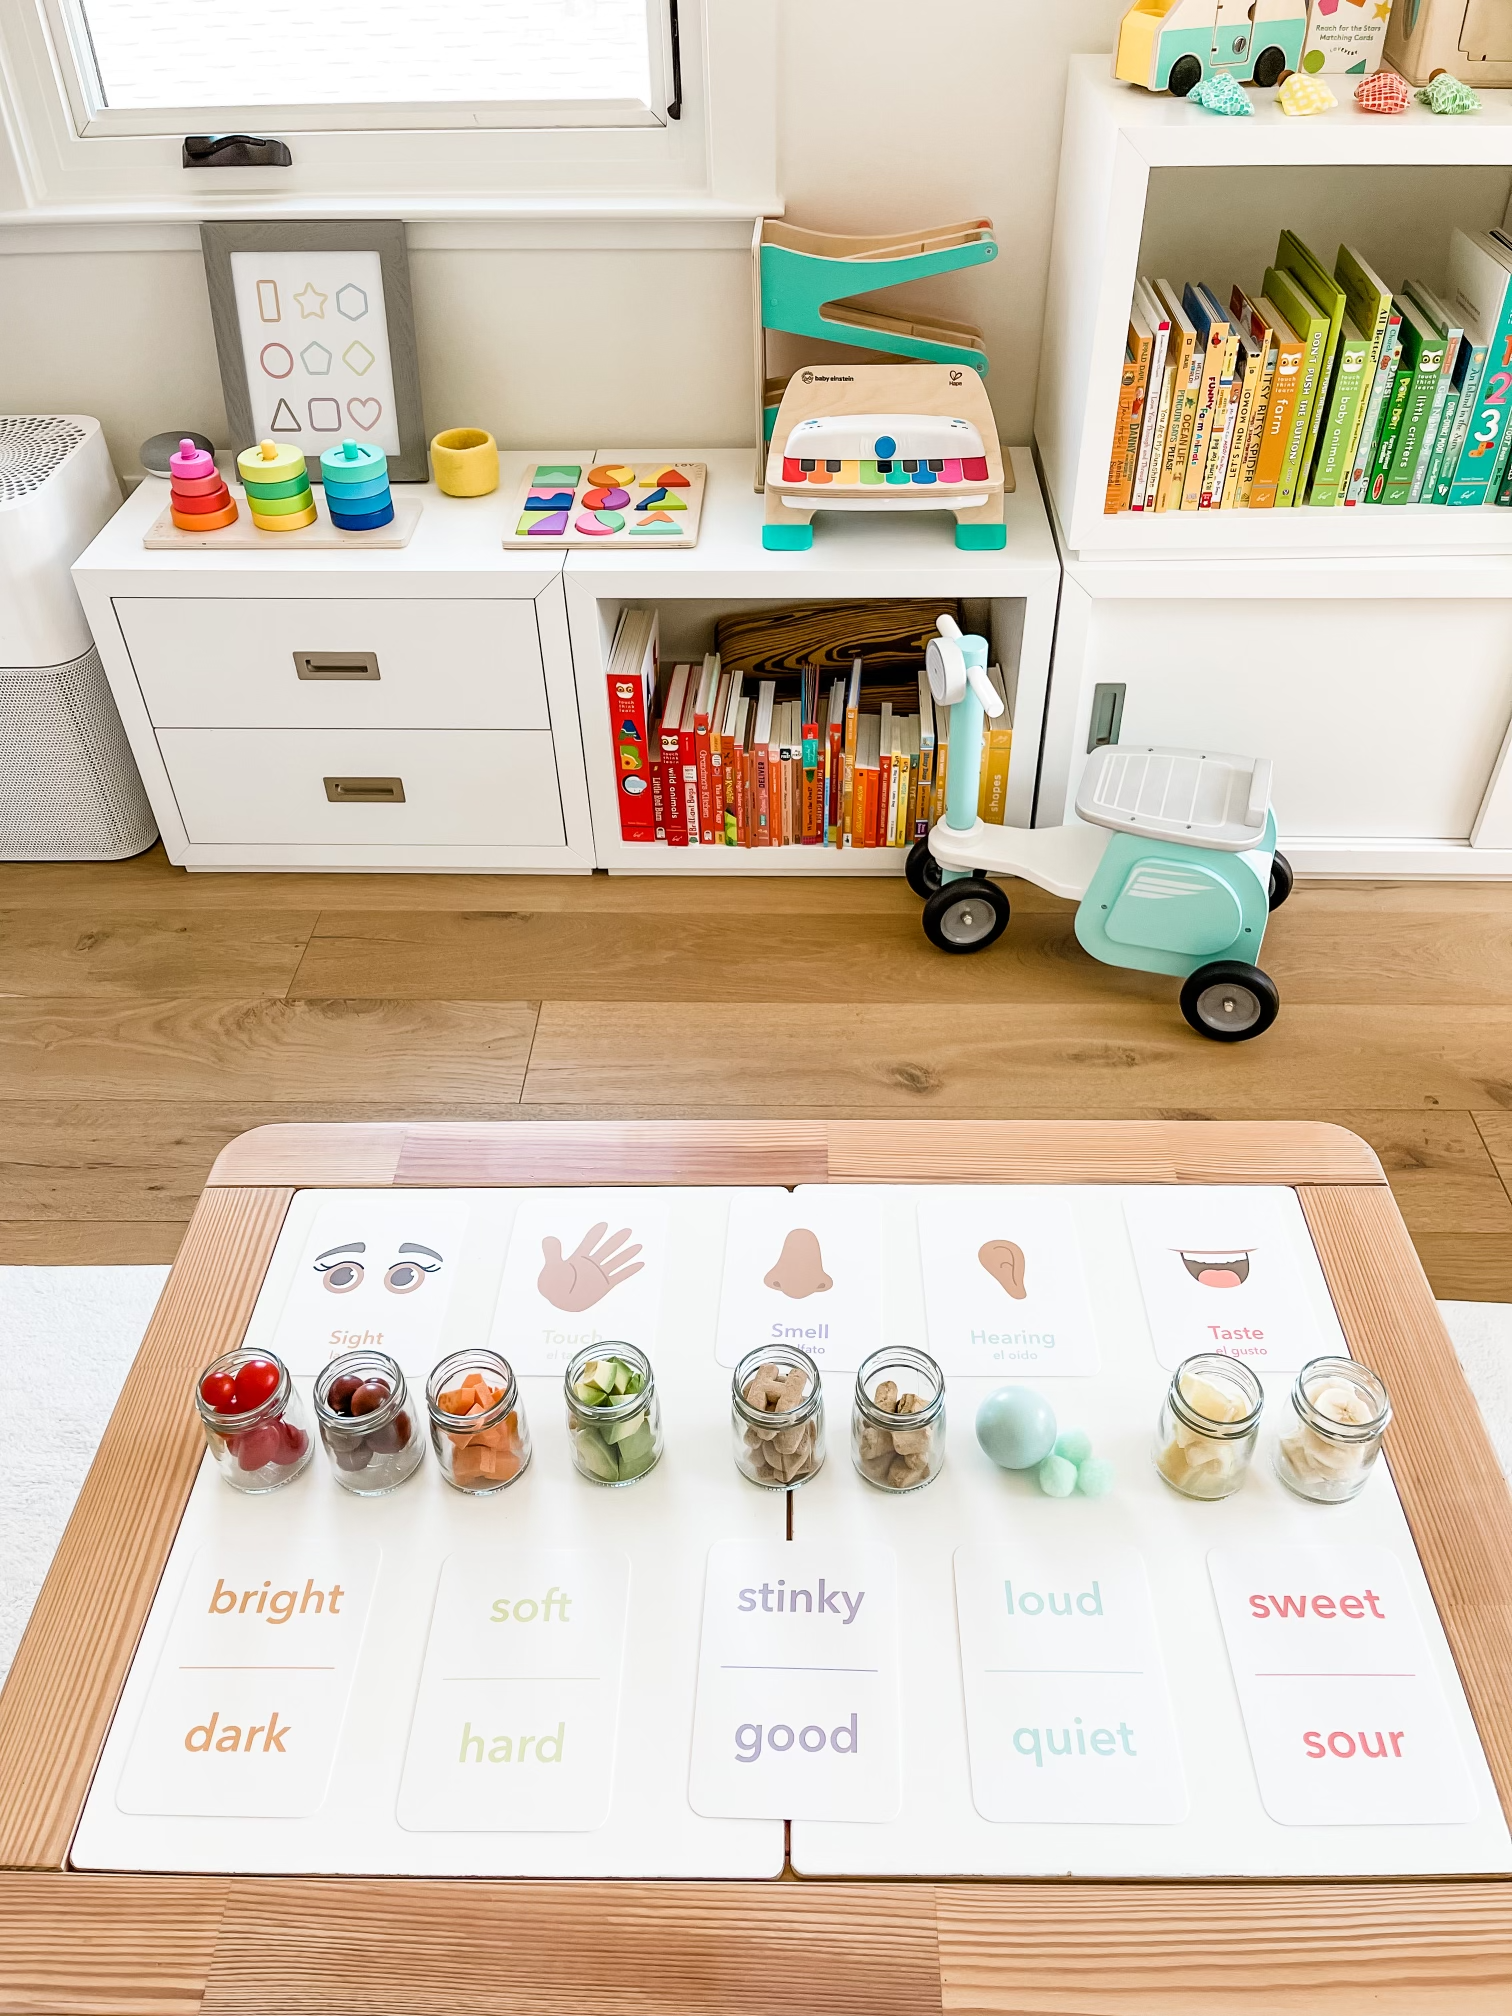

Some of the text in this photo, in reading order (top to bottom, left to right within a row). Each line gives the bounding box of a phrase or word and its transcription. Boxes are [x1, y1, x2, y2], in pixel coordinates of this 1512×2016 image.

[1320, 34, 1352, 42] Matching
[1370, 308, 1388, 363] All Better!
[1385, 329, 1396, 353] Church
[830, 374, 854, 382] einstein
[1137, 342, 1149, 382] ROALD DAHL
[1468, 368, 1479, 381] An
[1260, 373, 1273, 400] ITSY
[1383, 365, 1398, 398] PAIRS!
[1463, 383, 1477, 409] Island
[1483, 372, 1512, 405] 2
[1149, 396, 1158, 410] Love
[1289, 332, 1322, 465] DON'T PUSH THE BUTTON!
[1148, 411, 1156, 424] You
[1169, 389, 1186, 443] PENGUIN SAYS
[1191, 376, 1216, 466] FUNNY Farm Animals
[1270, 399, 1289, 435] farm
[1400, 395, 1427, 468] little critters
[1456, 418, 1467, 431] the
[1474, 408, 1501, 442] 3
[1127, 423, 1140, 454] DANNY
[1143, 425, 1153, 449] Through
[1149, 409, 1167, 488] You Are My Sunshine
[1176, 414, 1191, 466] OCEAN LIFE
[1229, 389, 1252, 478] LET'S FIND MOMO!
[1326, 397, 1351, 473] baby animals
[1451, 433, 1462, 451] Sun
[1244, 443, 1259, 483] SPIDER
[1382, 435, 1396, 470] Farm Animal
[1138, 461, 1148, 484] Through
[1416, 465, 1425, 482] tiger
[700, 750, 710, 818] Grandma's Kitchen
[757, 762, 766, 788] DELIVER
[652, 777, 664, 822] Little Red Barn
[668, 767, 679, 819] wild animals
[686, 788, 696, 804] Bugs
[989, 774, 1002, 812] shapes
[688, 805, 697, 832] Brilliant
[328, 1329, 384, 1349] Sight
[541, 1328, 603, 1345] Touch
[771, 1323, 829, 1339] Smell
[970, 1329, 1056, 1349] Hearing
[1207, 1325, 1264, 1340] Taste
[546, 1350, 558, 1360] el
[993, 1349, 1005, 1360] el
[1215, 1346, 1268, 1357] el gusto
[207, 1578, 345, 1625] bright
[488, 1586, 573, 1623] soft
[736, 1578, 865, 1625] stinky
[1003, 1580, 1104, 1617] loud
[1249, 1589, 1386, 1619] sweet
[184, 1711, 292, 1753] dark
[458, 1721, 566, 1764] hard
[734, 1713, 859, 1763] good
[1012, 1716, 1138, 1768] quiet
[1302, 1731, 1405, 1759] sour
